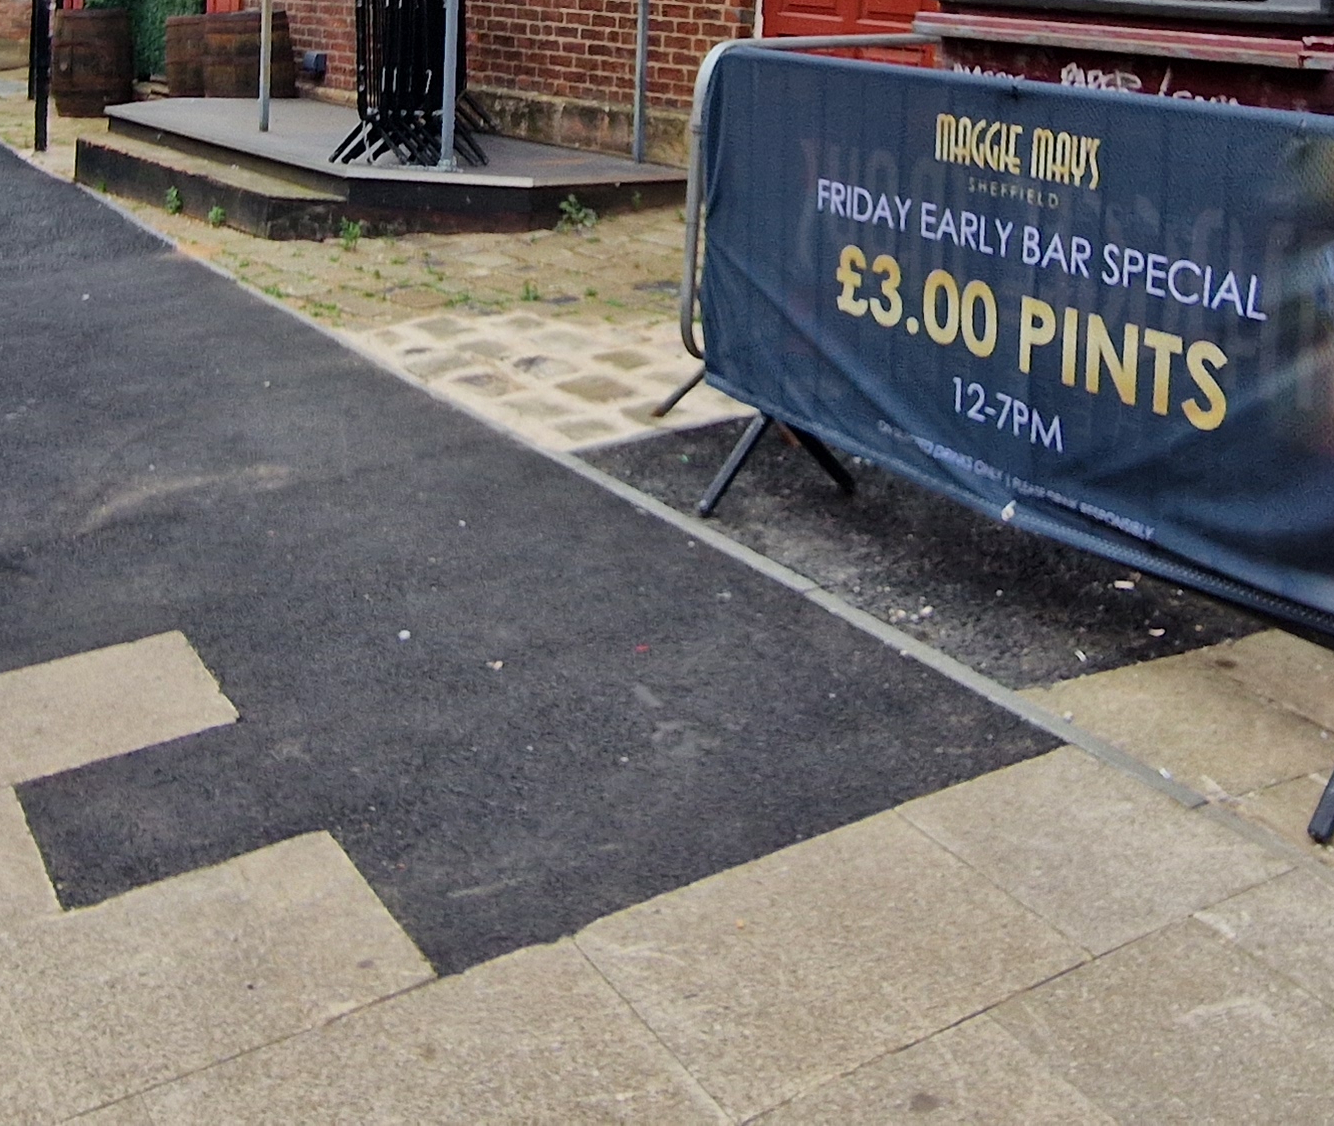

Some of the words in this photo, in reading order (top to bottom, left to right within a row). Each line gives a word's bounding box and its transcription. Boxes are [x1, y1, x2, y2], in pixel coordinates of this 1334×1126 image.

[934, 112, 1023, 175] MAGGIE
[1030, 127, 1101, 191] MAY'S
[968, 176, 1059, 209] SHEFFIELD
[817, 178, 912, 232] FRIDAY
[920, 202, 1014, 258] EARLY
[1022, 225, 1091, 279] BAR
[1101, 243, 1267, 321] SPECIAL
[836, 244, 998, 358] £3.00
[1018, 294, 1229, 432] PINTS
[952, 376, 1063, 453] 12-7PM
